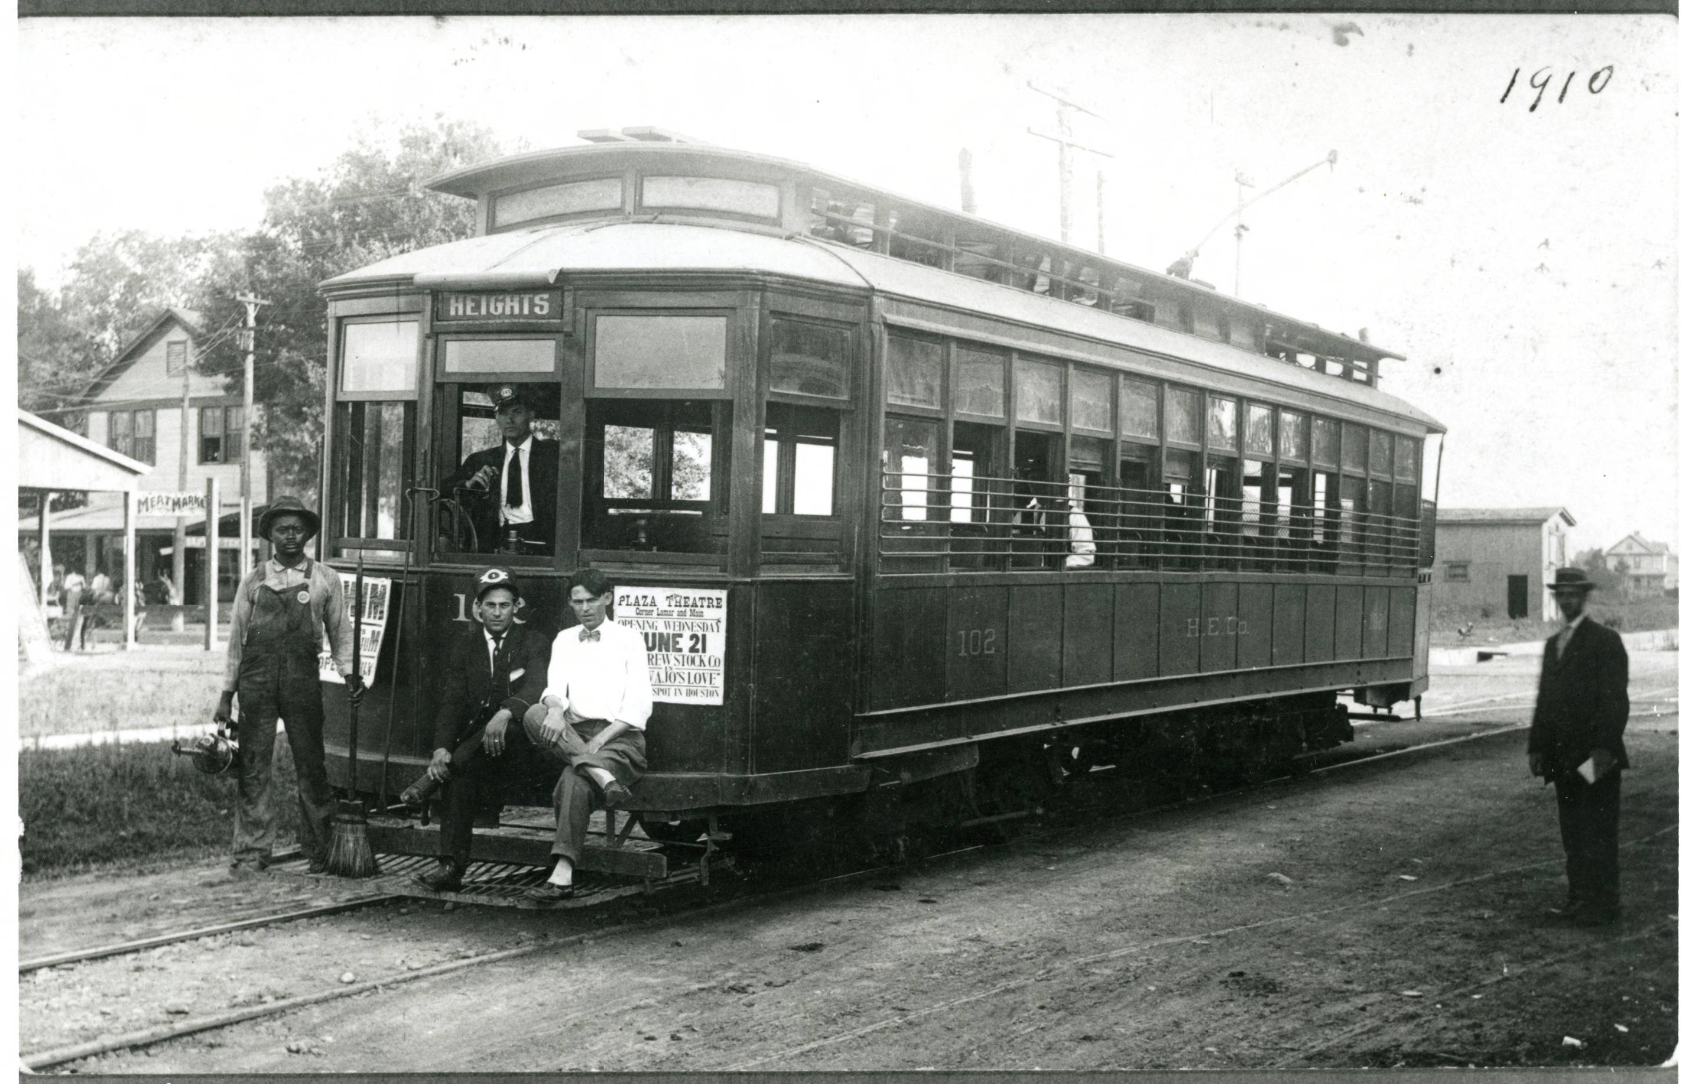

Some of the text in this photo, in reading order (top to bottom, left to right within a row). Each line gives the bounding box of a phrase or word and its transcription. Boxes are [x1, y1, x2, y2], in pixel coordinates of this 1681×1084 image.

[449, 293, 550, 316] HEIGHTS
[137, 495, 171, 514] MEAT
[617, 594, 723, 609] PLAZA THEATRE
[635, 607, 705, 618] Corner Lamar and Main
[663, 620, 722, 633] WEDNESDAY
[641, 631, 707, 654] UNE 21
[958, 628, 996, 657] 102
[673, 654, 707, 668] STOCK
[652, 687, 720, 698] SPOT IN HOUSTON
